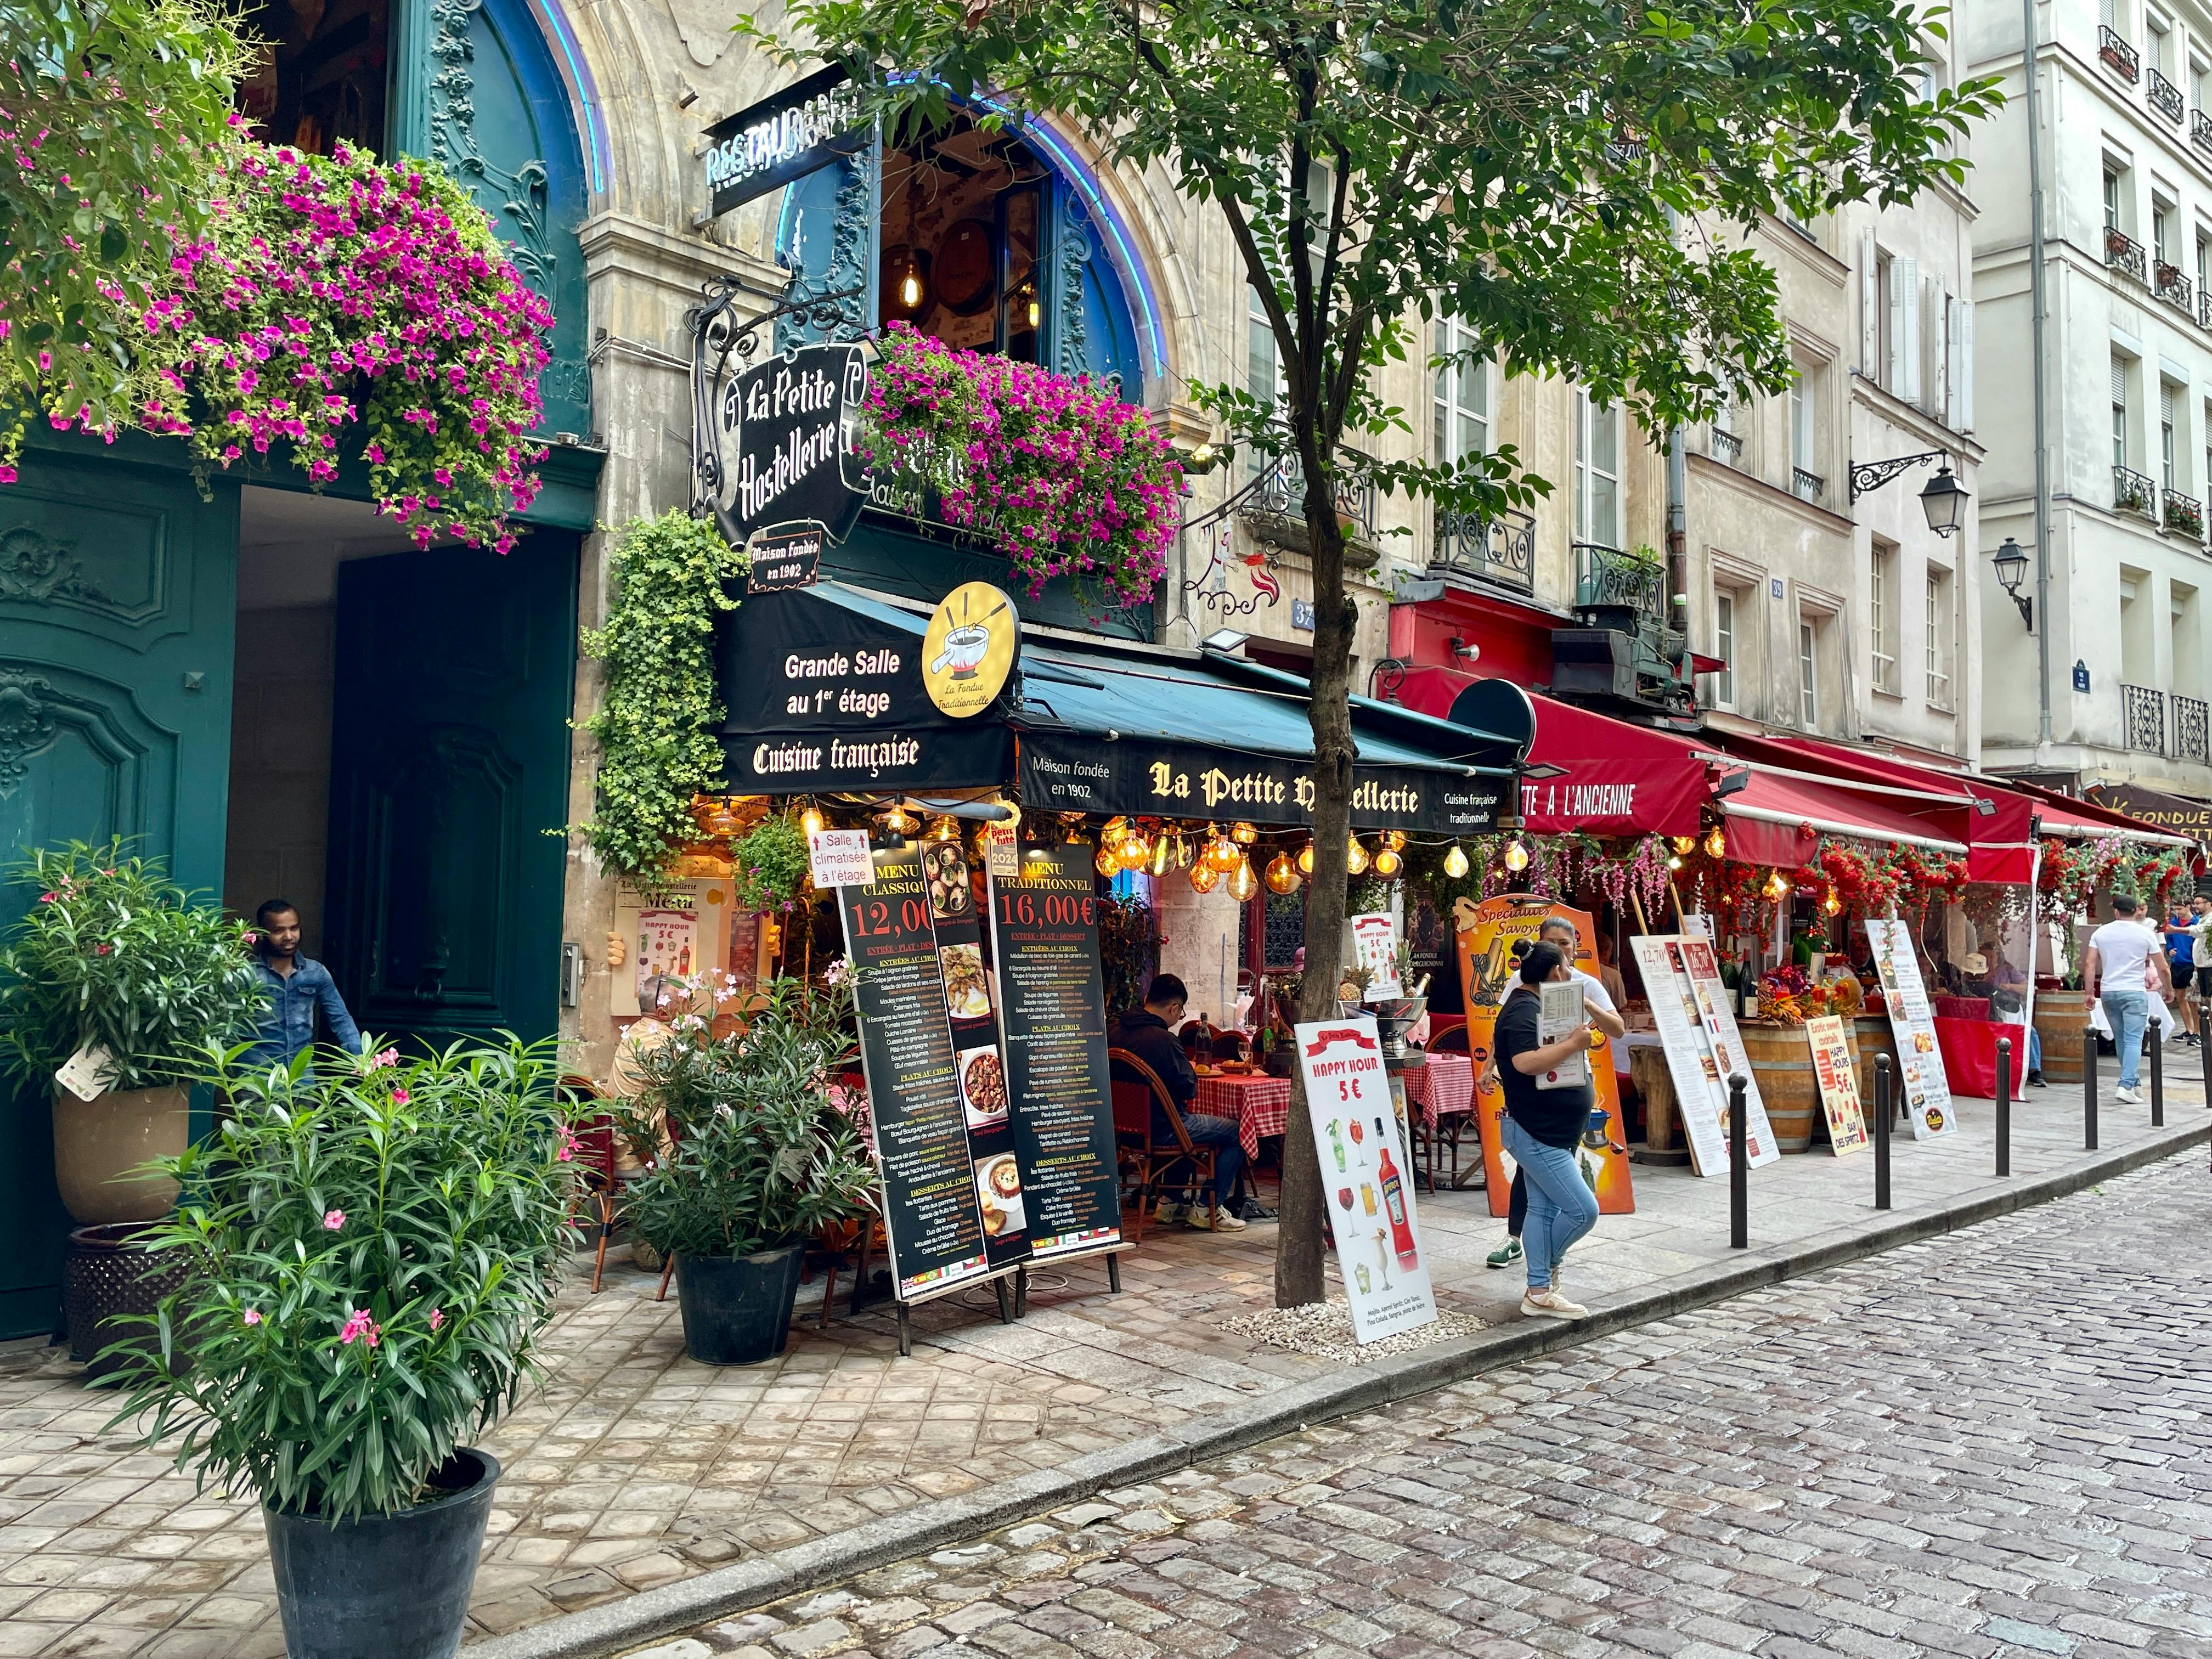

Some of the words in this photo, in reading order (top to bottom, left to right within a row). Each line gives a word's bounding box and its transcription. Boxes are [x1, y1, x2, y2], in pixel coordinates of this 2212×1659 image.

[746, 379, 769, 421] La
[772, 366, 836, 418] Petite
[740, 420, 836, 521] Hostellerie
[752, 543, 786, 563] Maison
[788, 539, 819, 558] fondée
[767, 568, 779, 580] en
[780, 563, 802, 579] 1902
[1773, 581, 1782, 596] 39
[1296, 603, 1314, 625] 37
[785, 652, 848, 679] Grande
[854, 649, 900, 675] Salle
[945, 684, 955, 695] La
[957, 682, 984, 694] Fondue
[787, 696, 809, 714] au
[815, 689, 834, 713] 1er
[839, 687, 890, 718] étage
[938, 695, 989, 709] Traditionnelle
[753, 742, 821, 774] Cuisine
[830, 734, 919, 778] française
[1033, 757, 1070, 775] Maison
[1073, 760, 1110, 778] fondée
[1052, 785, 1064, 795] en
[1067, 783, 1091, 798] 1902
[1149, 760, 1191, 799] La
[1199, 768, 1286, 807] Petite
[1293, 775, 1419, 813] Hellerie
[1444, 793, 1469, 805] Cuisine
[1470, 795, 1497, 807] française
[1547, 785, 1555, 816] A
[1564, 783, 1636, 816] L'ANCIENNE
[1450, 811, 1489, 824] traditionnelle
[2132, 811, 2211, 825] FONDUE
[827, 834, 852, 847] Salle
[991, 828, 1013, 839] petit
[996, 836, 1014, 845] futé
[815, 849, 867, 865] climatisée
[993, 853, 1017, 864] 2024
[822, 871, 828, 882] à
[832, 868, 866, 883] l'étage
[876, 864, 918, 878] MENU
[1025, 862, 1063, 875] MENU
[998, 878, 1092, 891] TRADITIONNEL
[1000, 894, 1093, 929] 16,00€
[658, 930, 664, 939] 5
[1496, 921, 1542, 936] Savoya
[879, 957, 910, 967] ENTRÉES
[1830, 1046, 1845, 1058] HAPPY
[1312, 1060, 1346, 1077] HAPPY
[1348, 1057, 1378, 1073] HOUR
[1833, 1057, 1849, 1069] HOURS
[901, 1073, 922, 1082] PLATS
[933, 1066, 953, 1076] CHOIX
[1339, 1080, 1348, 1101] 5
[1351, 1078, 1362, 1099] €
[1836, 1073, 1850, 1093] 5€
[1847, 1122, 1857, 1132] BAR
[1836, 1138, 1845, 1148] DES
[1845, 1133, 1860, 1146] SPRITZ
[1036, 1158, 1066, 1166] DESSERTS
[1076, 1153, 1096, 1161] CHOIX
[911, 1183, 945, 1197] DESSERTS
[946, 1180, 955, 1188] AU
[956, 1175, 973, 1186] CHOI
